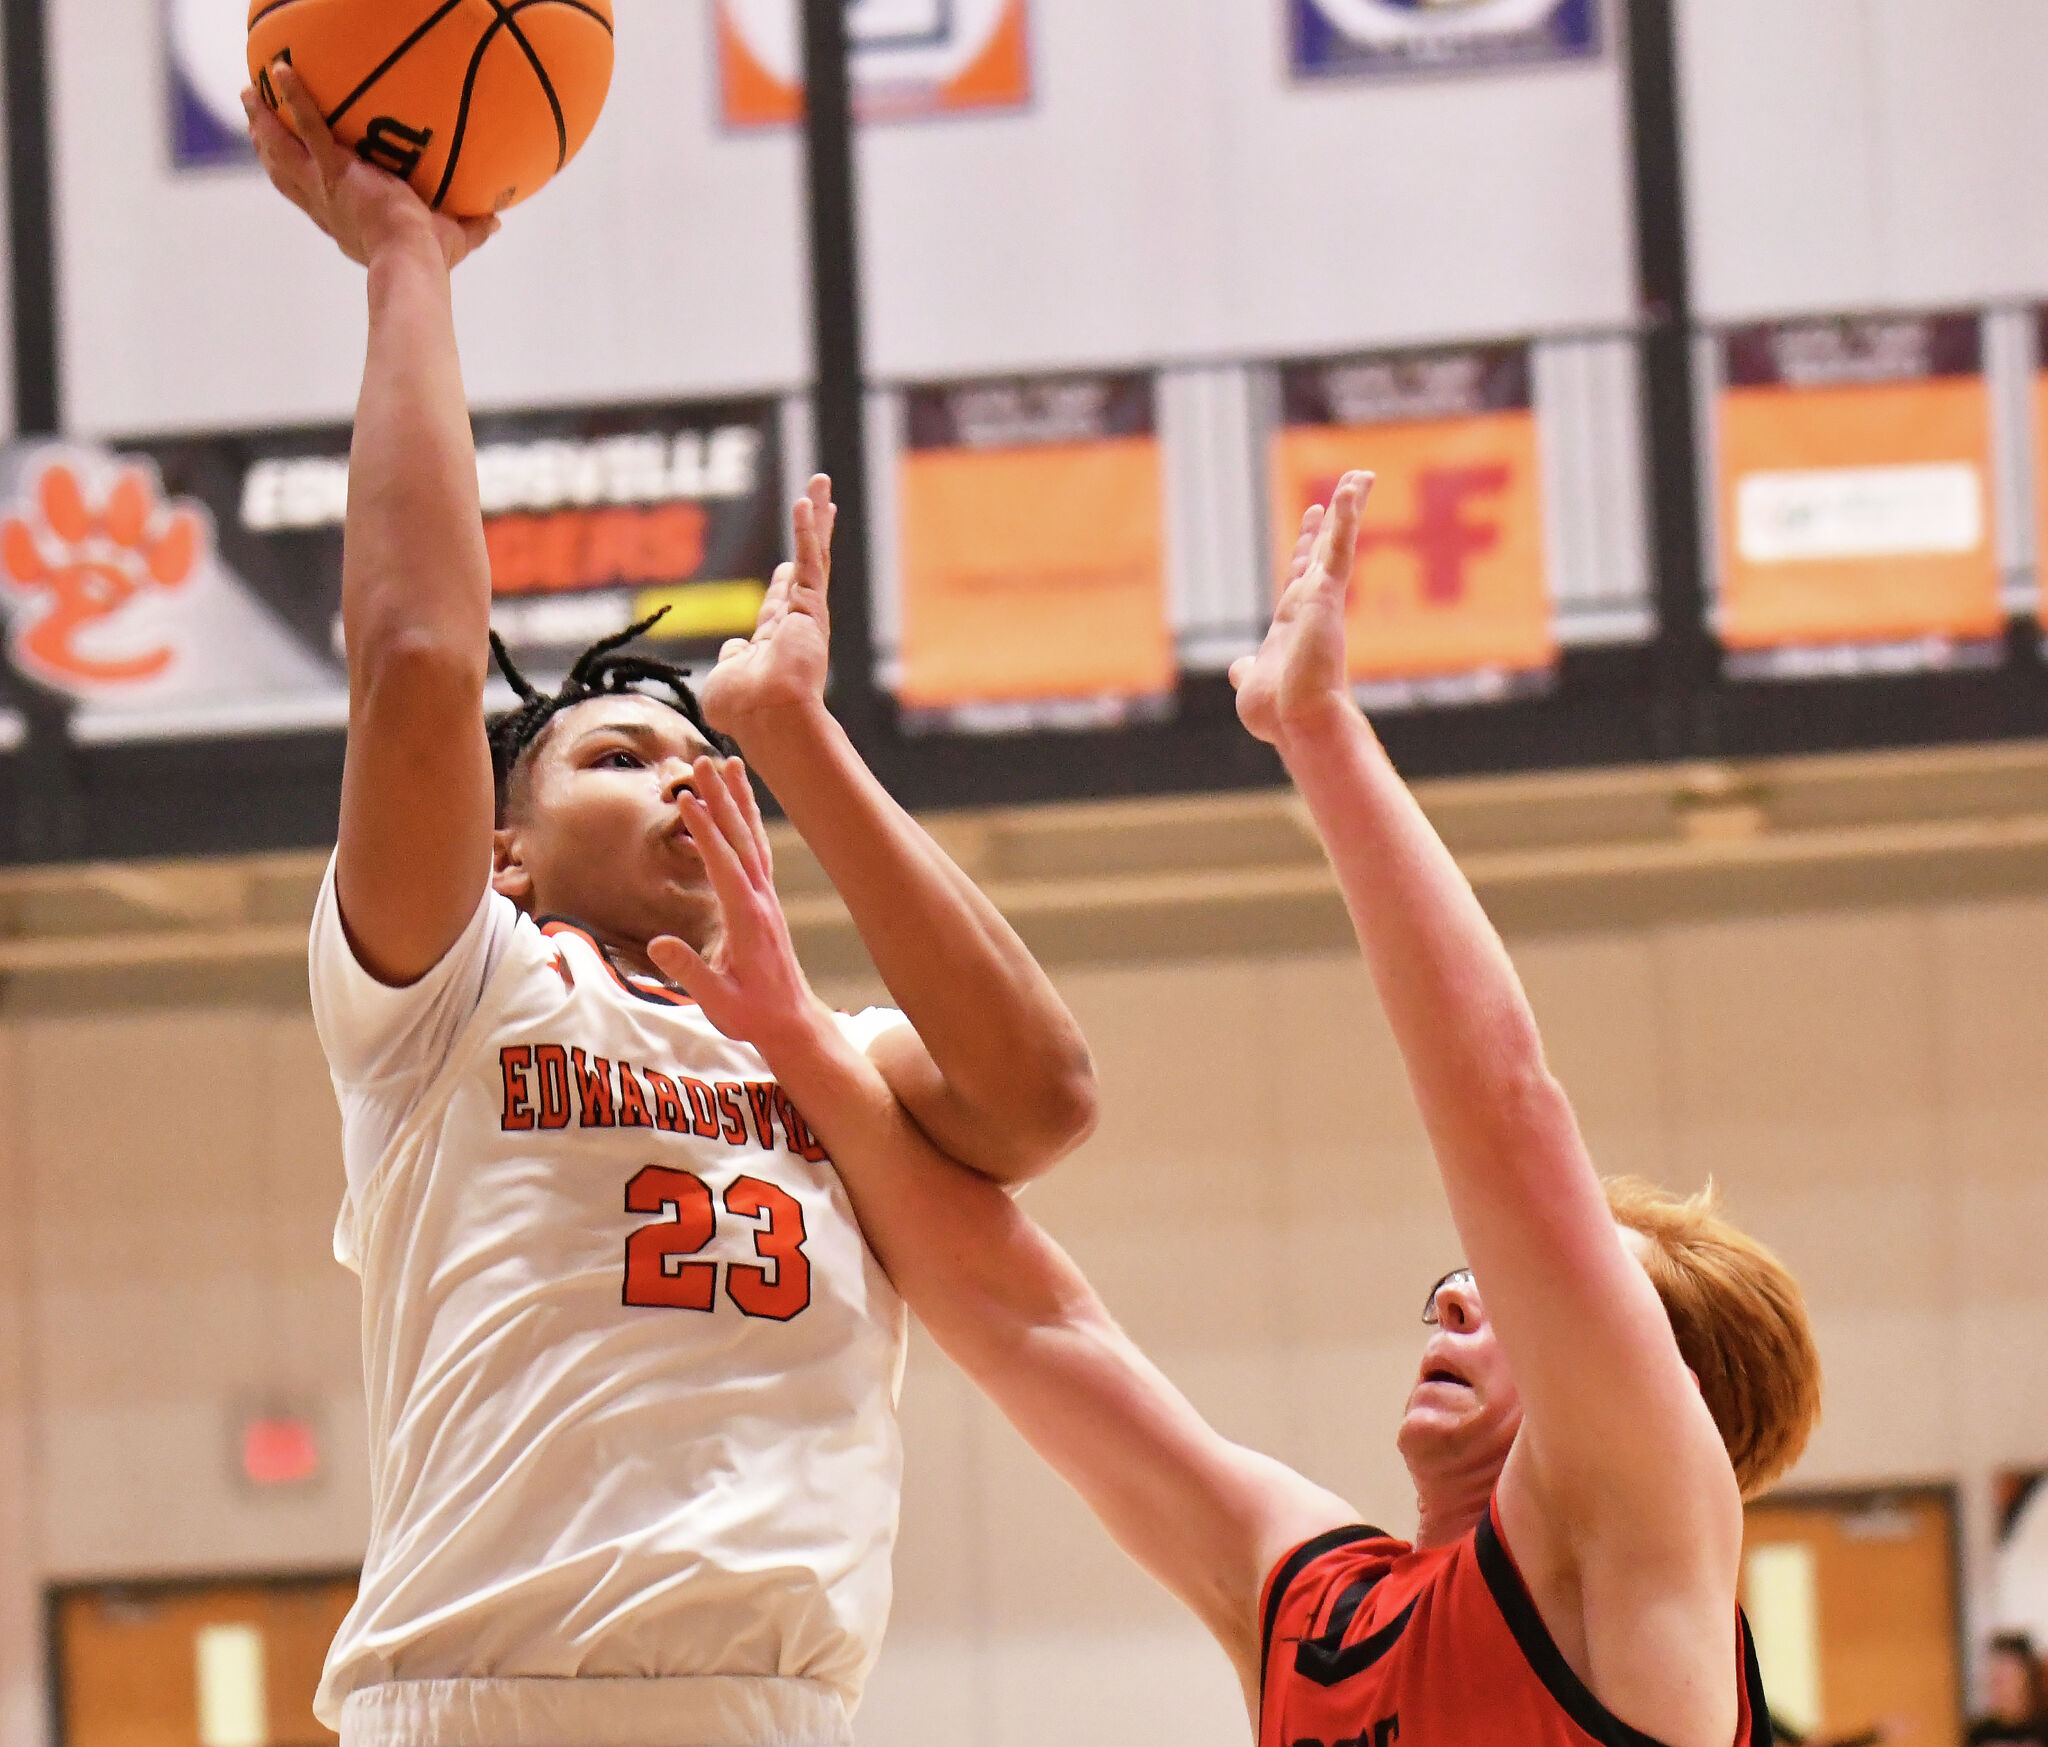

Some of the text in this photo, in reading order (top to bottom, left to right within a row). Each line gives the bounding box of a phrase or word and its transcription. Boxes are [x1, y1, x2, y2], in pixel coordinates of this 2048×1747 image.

[240, 425, 762, 532] EDDSVILLE
[500, 1044, 830, 1163] EDWARDSVIL
[622, 1164, 812, 1322] 23
